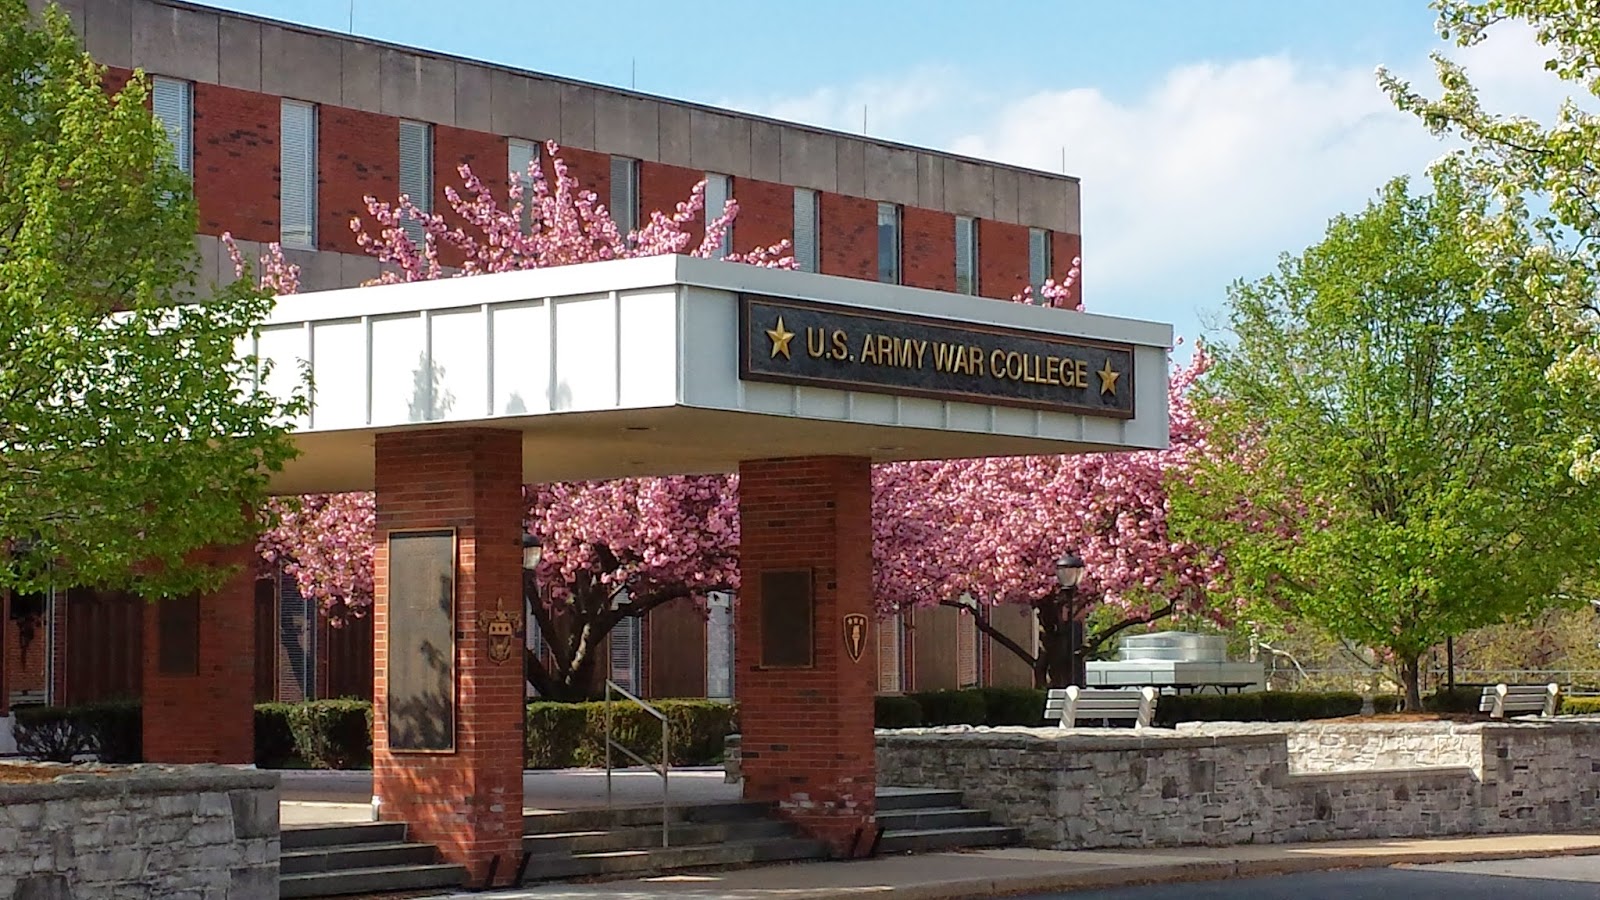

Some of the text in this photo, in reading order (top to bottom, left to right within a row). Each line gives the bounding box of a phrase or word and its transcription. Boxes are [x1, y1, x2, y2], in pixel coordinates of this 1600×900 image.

[806, 326, 1088, 388] U.S. ARMY WAR COLLEGE
